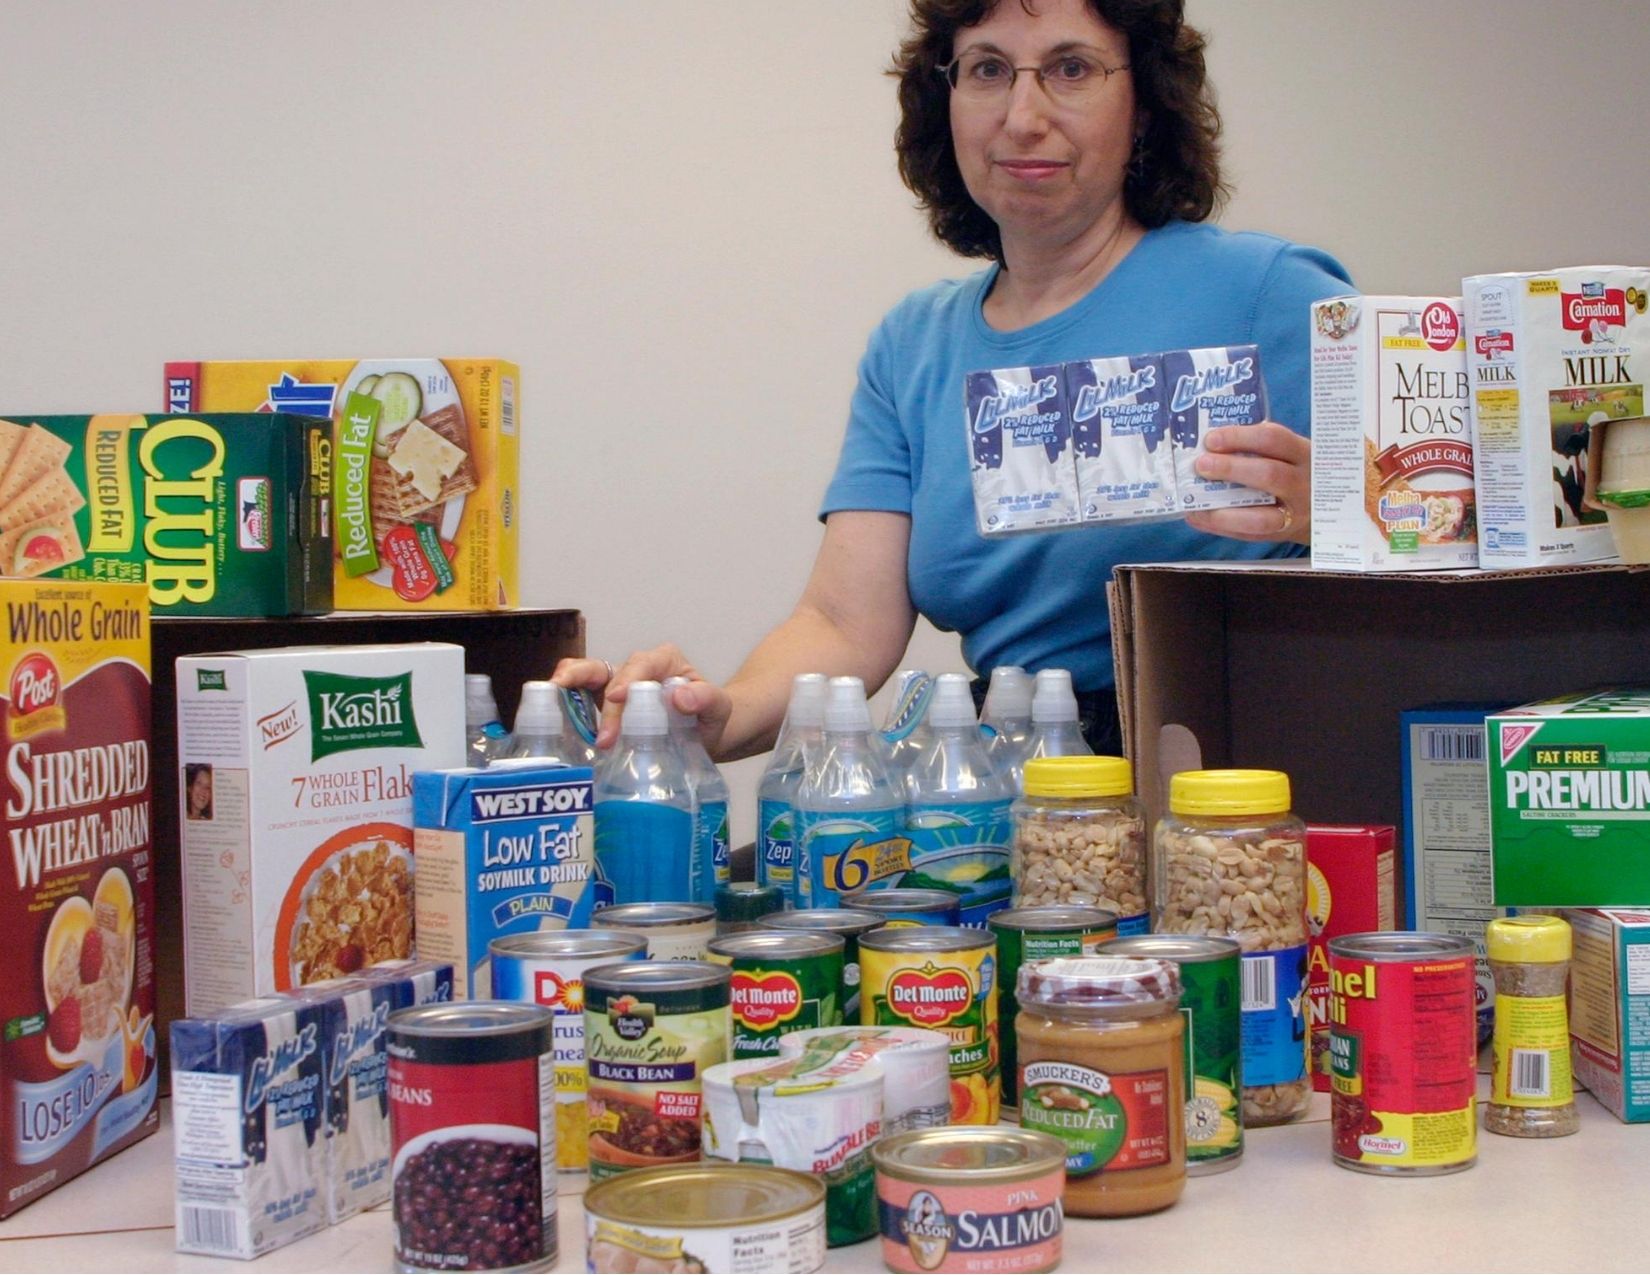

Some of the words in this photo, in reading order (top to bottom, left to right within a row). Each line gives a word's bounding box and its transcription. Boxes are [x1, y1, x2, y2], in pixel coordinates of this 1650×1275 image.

[1481, 292, 1502, 300] SPOUT
[1431, 306, 1452, 325] Old
[1569, 299, 1621, 323] Carnation
[1425, 312, 1456, 343] London
[1405, 339, 1420, 347] FREE
[1479, 338, 1509, 350] Carnation
[1477, 366, 1517, 381] MILK
[1563, 355, 1633, 386] MILK
[1396, 362, 1469, 400] MELB
[1119, 402, 1159, 416] REDUCED
[1216, 393, 1257, 406] REDUCED
[1020, 411, 1061, 425] REDUCED
[1112, 416, 1127, 427] FAT
[1130, 413, 1154, 425] MILK
[1210, 408, 1224, 418] FAT
[1228, 405, 1250, 416] MILK
[342, 412, 372, 449] Fat
[1014, 427, 1029, 437] FAT
[1032, 424, 1055, 434] MILK
[319, 439, 332, 495] CLUB
[1401, 449, 1440, 469] WHOLE
[96, 430, 122, 511] REDUCED
[138, 418, 226, 607] CLUB
[341, 451, 371, 560] Reduced
[100, 512, 125, 539] FAT
[1388, 519, 1420, 531] PLAN
[408, 539, 416, 551] Fat
[406, 559, 418, 579] Whole
[413, 551, 424, 569] Trans
[402, 570, 414, 589] Made
[8, 602, 83, 643] Whole
[90, 600, 141, 641] Grain
[17, 668, 55, 709] Post
[199, 673, 224, 686] Kashi
[319, 683, 403, 730] Kashi
[260, 708, 299, 744] New!
[322, 734, 332, 742] The
[1536, 750, 1559, 764] FAT
[1564, 750, 1599, 764] FREE
[6, 739, 149, 821] SHREDDED
[290, 776, 306, 808] 7
[307, 771, 359, 789] WHOLE
[311, 788, 359, 809] GRAIN
[9, 813, 101, 891] WHEAT
[110, 801, 149, 856] BRAN
[538, 824, 582, 860] Fat
[766, 839, 793, 861] Zep
[834, 838, 869, 893] 6
[478, 867, 535, 892] SOYMILK
[540, 863, 588, 883] DRINK
[509, 897, 553, 916] PLAIN
[1025, 939, 1058, 949] Nutrition
[1059, 938, 1079, 948] Facts
[1309, 945, 1329, 973] A
[749, 987, 797, 1004] Monte
[893, 985, 917, 1003] Del
[919, 984, 967, 1002] Monte
[743, 1005, 775, 1019] Quality
[914, 1005, 946, 1019] Quality
[554, 1025, 584, 1038] rus
[617, 1017, 643, 1028] Health
[619, 1026, 645, 1038] Valley
[590, 1033, 645, 1062] Organic
[647, 1036, 688, 1062] Soup
[733, 1034, 760, 1050] Fresh
[599, 1063, 635, 1080] BLACK
[637, 1064, 675, 1080] BEAN
[1025, 1066, 1104, 1092] SMUCKER'S
[21, 1090, 73, 1142] LOSE
[76, 1071, 96, 1113] 10
[658, 1093, 676, 1106] NO
[677, 1094, 699, 1106] SALT
[658, 1105, 697, 1117] ADDED
[1021, 1102, 1086, 1129] REDUCED
[1084, 1108, 1118, 1130] FAT
[1195, 1110, 1207, 1128] 8
[1363, 1137, 1402, 1153] Hormel
[1007, 1190, 1038, 1206] PINK
[903, 1220, 951, 1239] SEASON
[957, 1197, 1064, 1249] SALMON
[733, 1230, 781, 1245] Nutrition
[733, 1246, 764, 1259] Facts
